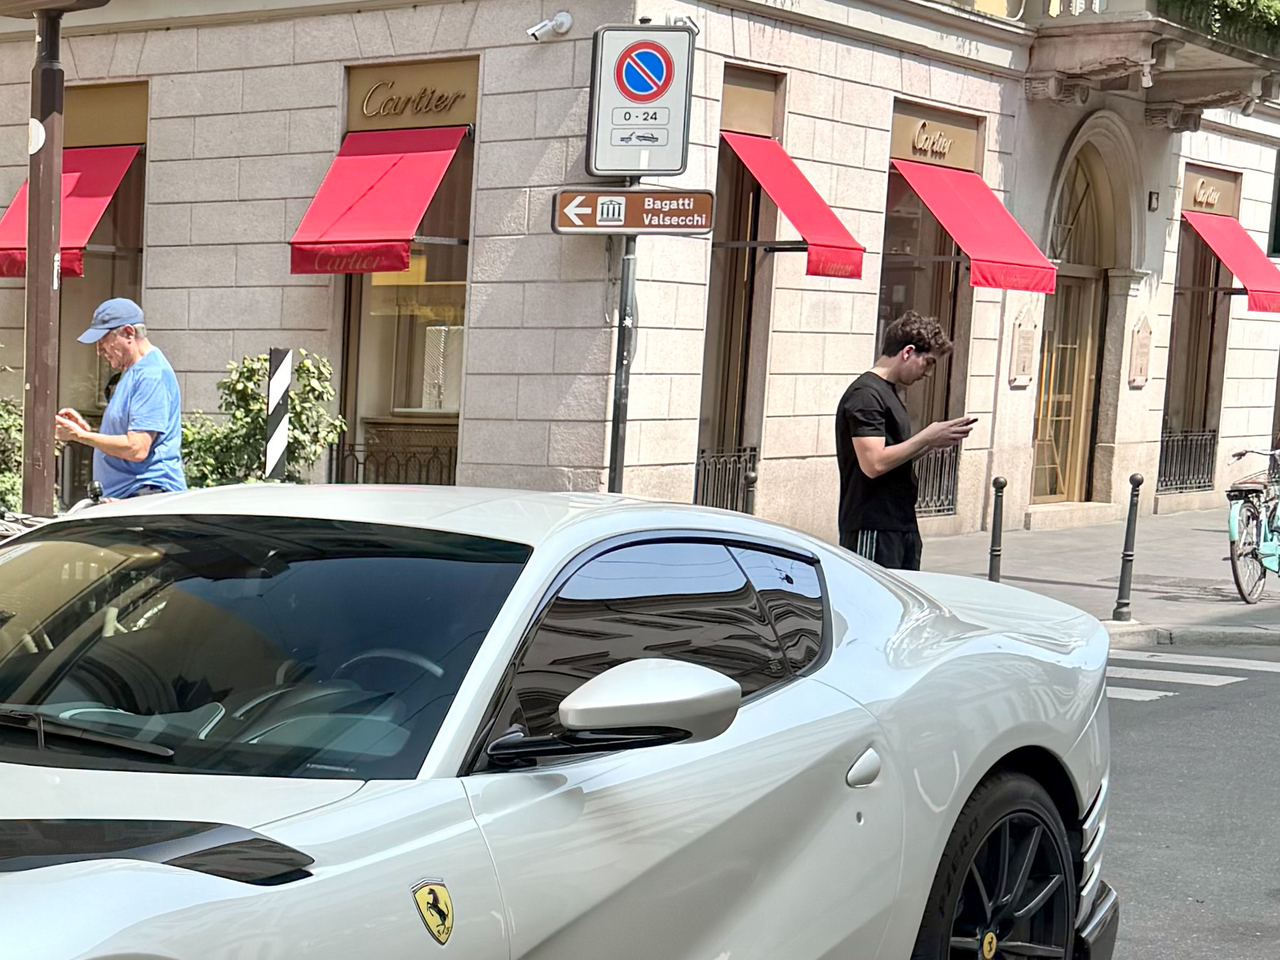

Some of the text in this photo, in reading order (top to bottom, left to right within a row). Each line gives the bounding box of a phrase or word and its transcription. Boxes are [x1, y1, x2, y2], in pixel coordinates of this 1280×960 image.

[362, 81, 466, 118] Cartier
[623, 112, 631, 121] 0
[642, 111, 658, 122] 24
[914, 119, 955, 155] Cartier
[644, 198, 694, 212] Bagatti
[642, 213, 706, 226] Valsecchi
[315, 248, 384, 271] Cartier
